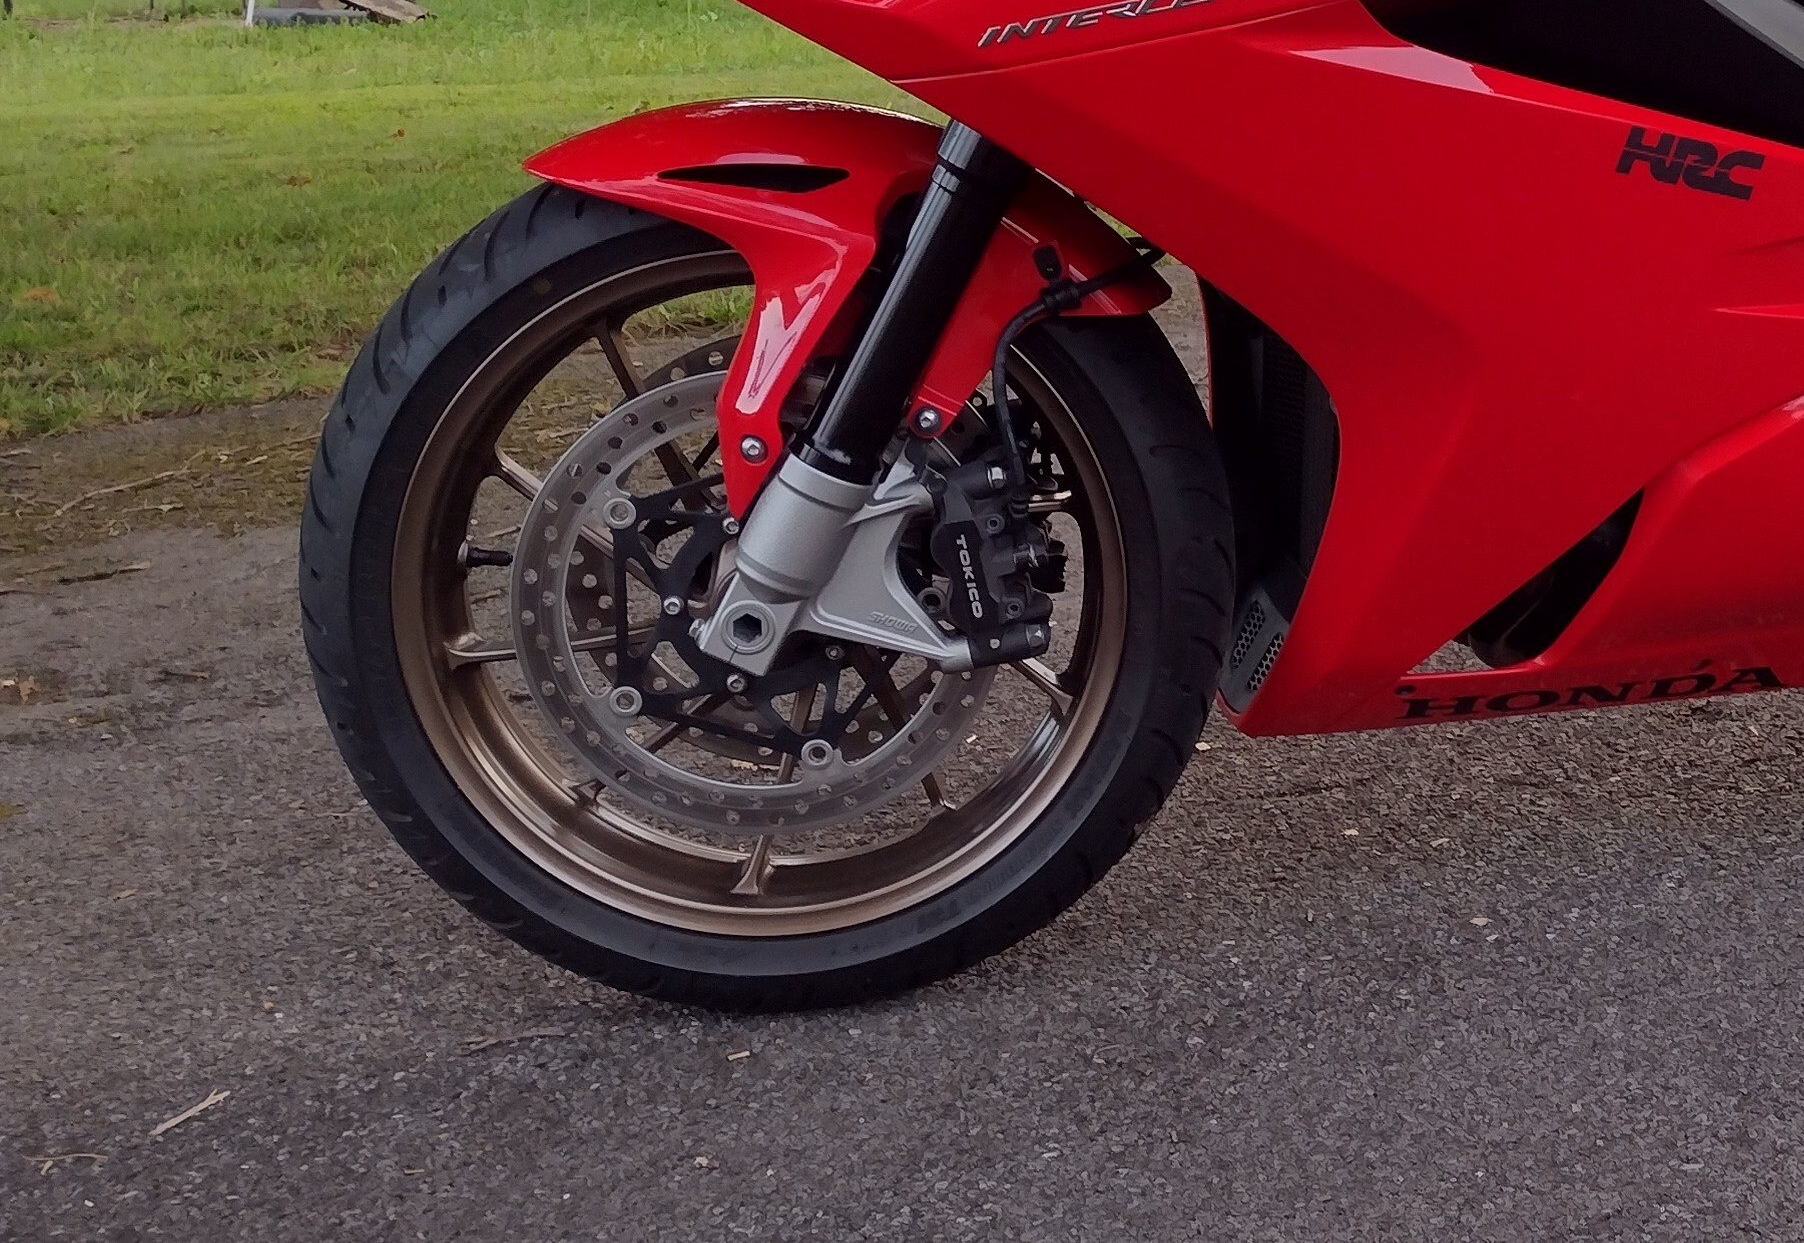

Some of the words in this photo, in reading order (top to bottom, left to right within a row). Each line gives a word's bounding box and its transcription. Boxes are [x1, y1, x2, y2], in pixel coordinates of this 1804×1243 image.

[1615, 125, 1766, 201] HRC
[955, 534, 983, 618] TOKICO
[869, 610, 918, 634] SHOWA
[1395, 666, 1791, 720] HONDA
